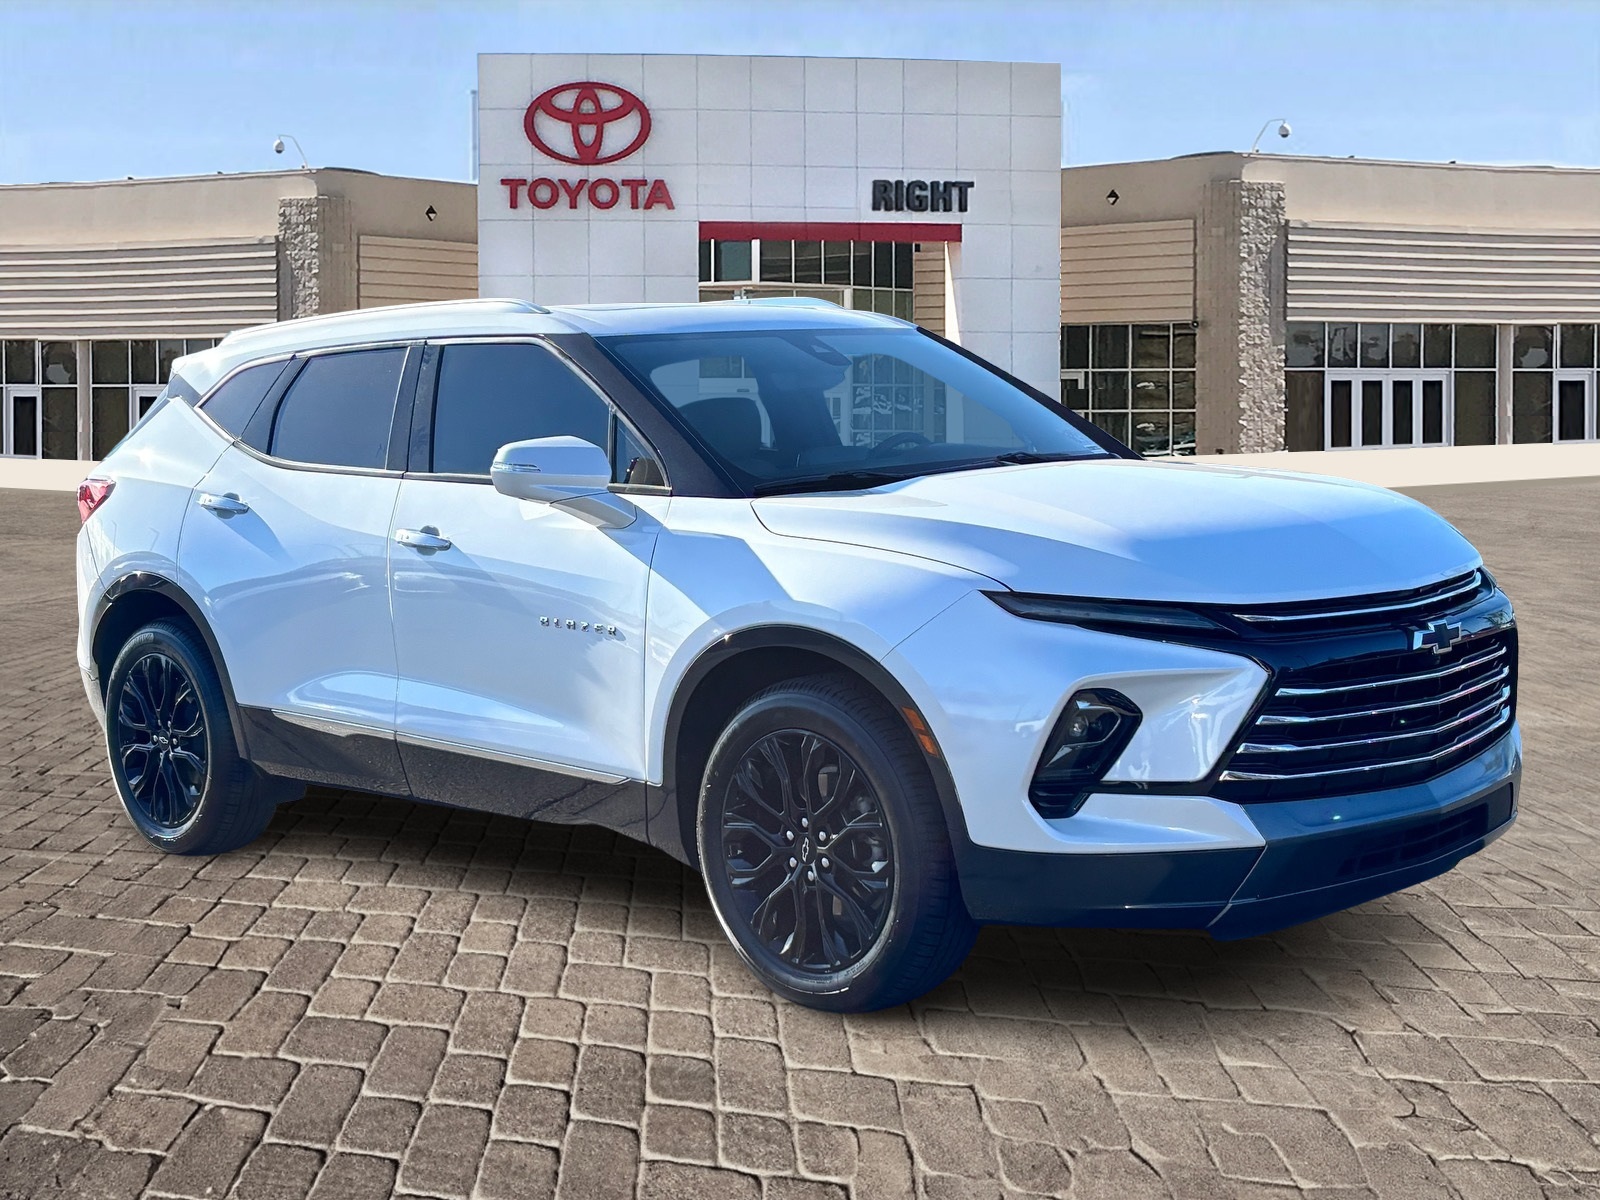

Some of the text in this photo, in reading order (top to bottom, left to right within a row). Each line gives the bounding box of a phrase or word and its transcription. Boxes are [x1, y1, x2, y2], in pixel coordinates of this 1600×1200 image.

[500, 177, 675, 210] TOYOTA
[872, 179, 975, 213] RIGHT
[540, 616, 617, 636] BLAZER
